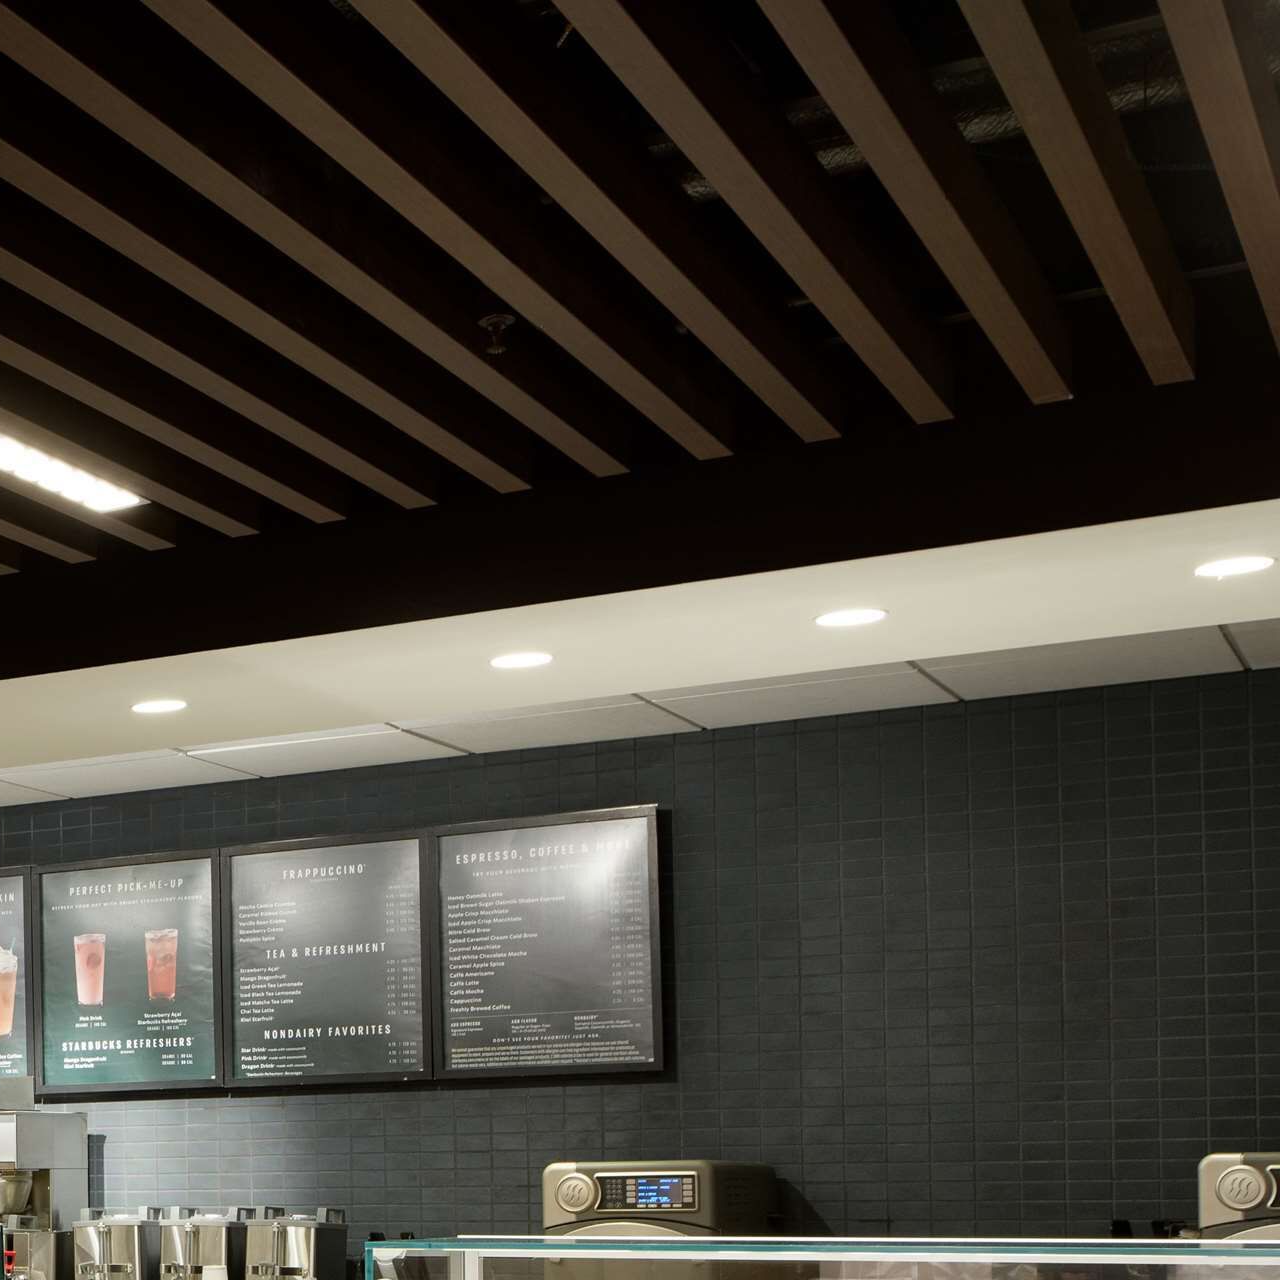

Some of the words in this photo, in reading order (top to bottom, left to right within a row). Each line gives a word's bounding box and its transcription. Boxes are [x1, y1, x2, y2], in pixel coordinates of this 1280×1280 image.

[456, 850, 522, 864] ESPRESSO,
[530, 844, 575, 858] COFFEE
[69, 884, 112, 896] PERFECT
[118, 878, 184, 893] PICK-ME-UP
[266, 950, 285, 959] TEA
[292, 948, 298, 958] &
[305, 942, 386, 957] REFRESHMENT
[264, 1028, 322, 1040] NONDAIRY
[328, 1024, 391, 1037] FAVORITES
[62, 1040, 122, 1052] STARBUCKS
